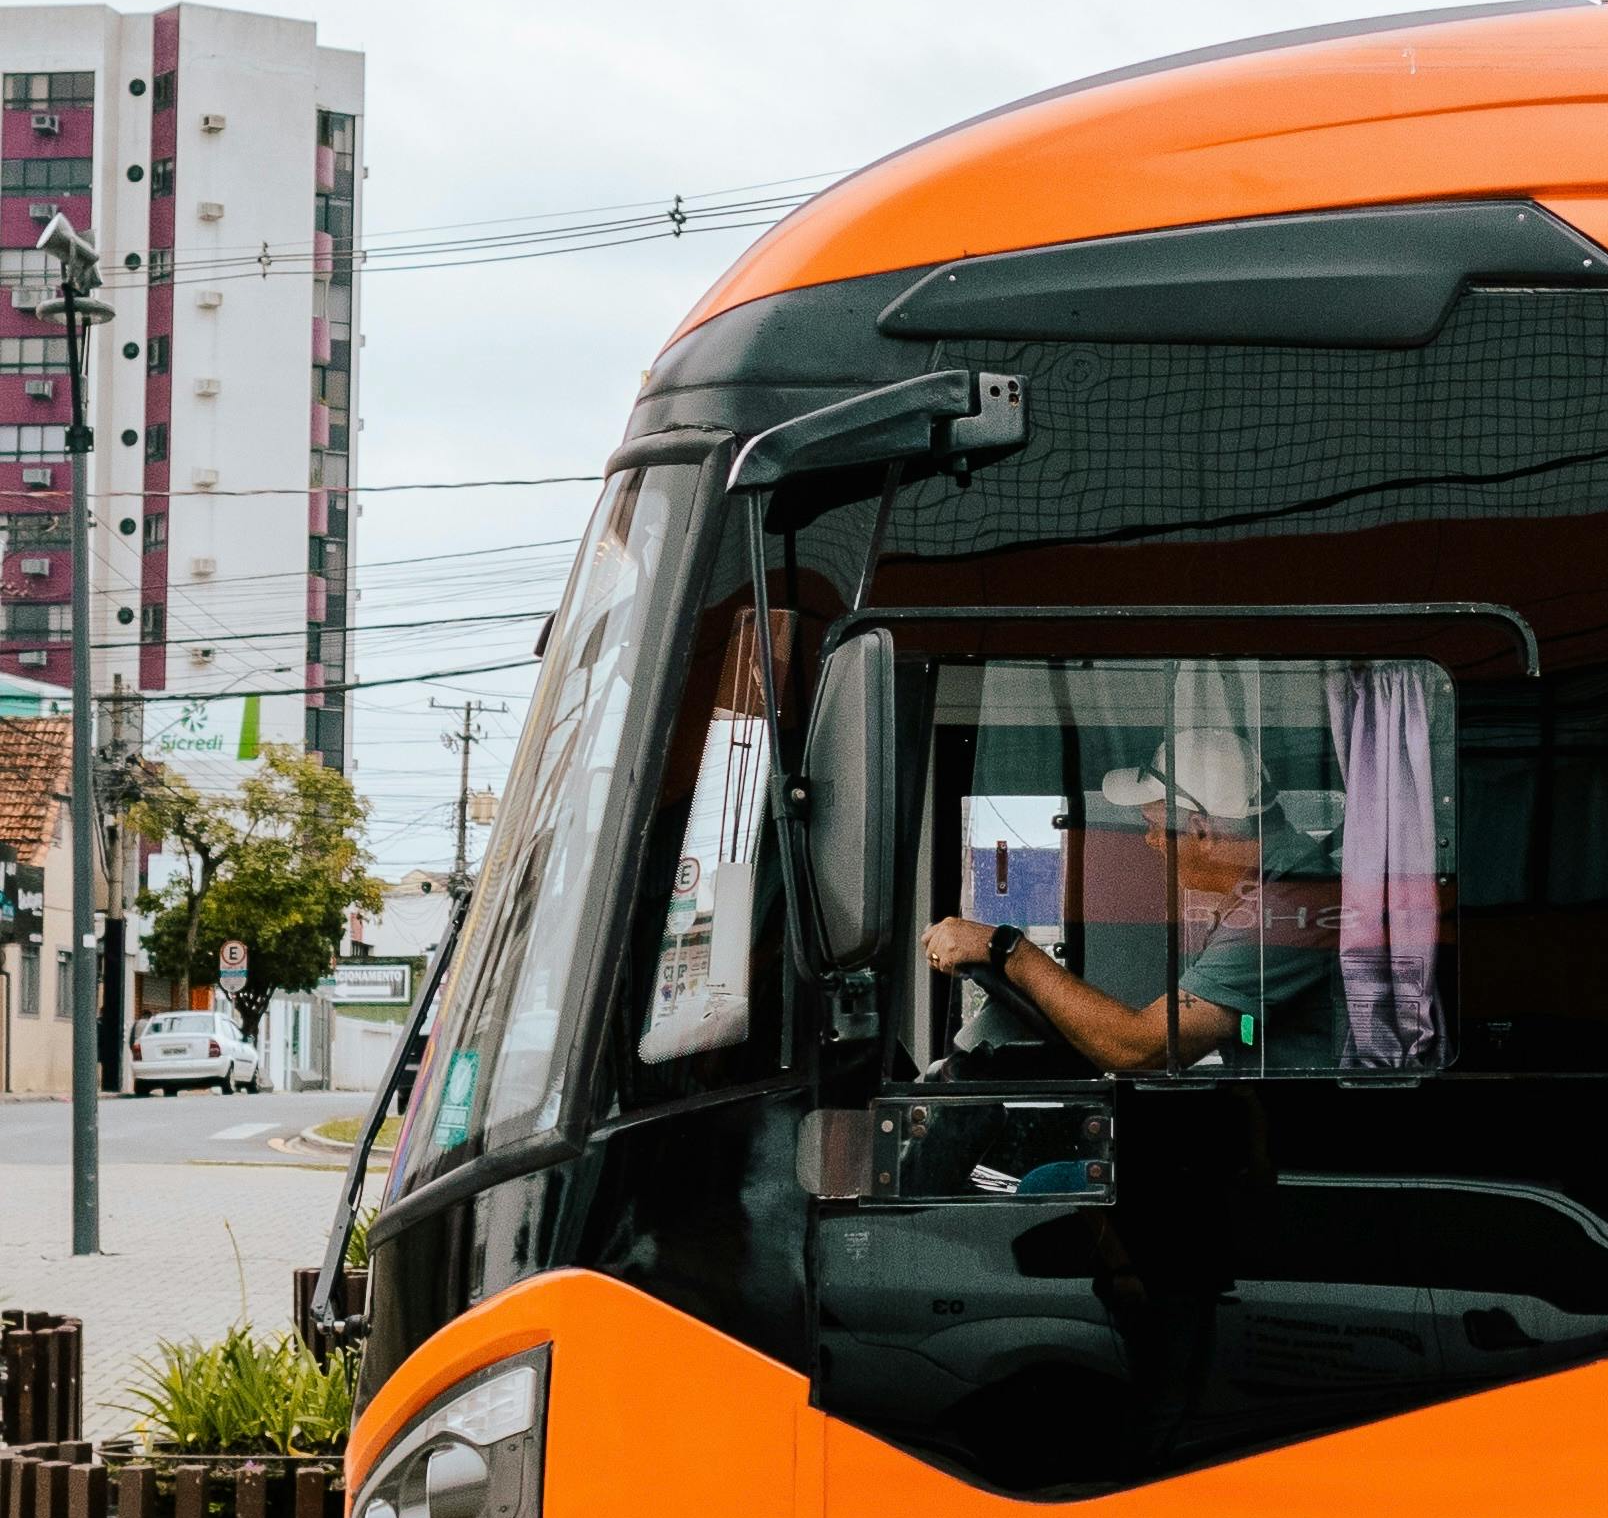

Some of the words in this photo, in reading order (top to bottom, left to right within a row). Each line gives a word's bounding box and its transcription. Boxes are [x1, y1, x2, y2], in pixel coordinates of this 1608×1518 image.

[160, 734, 223, 751] Sicredi
[680, 865, 693, 885] E
[228, 946, 239, 961] E
